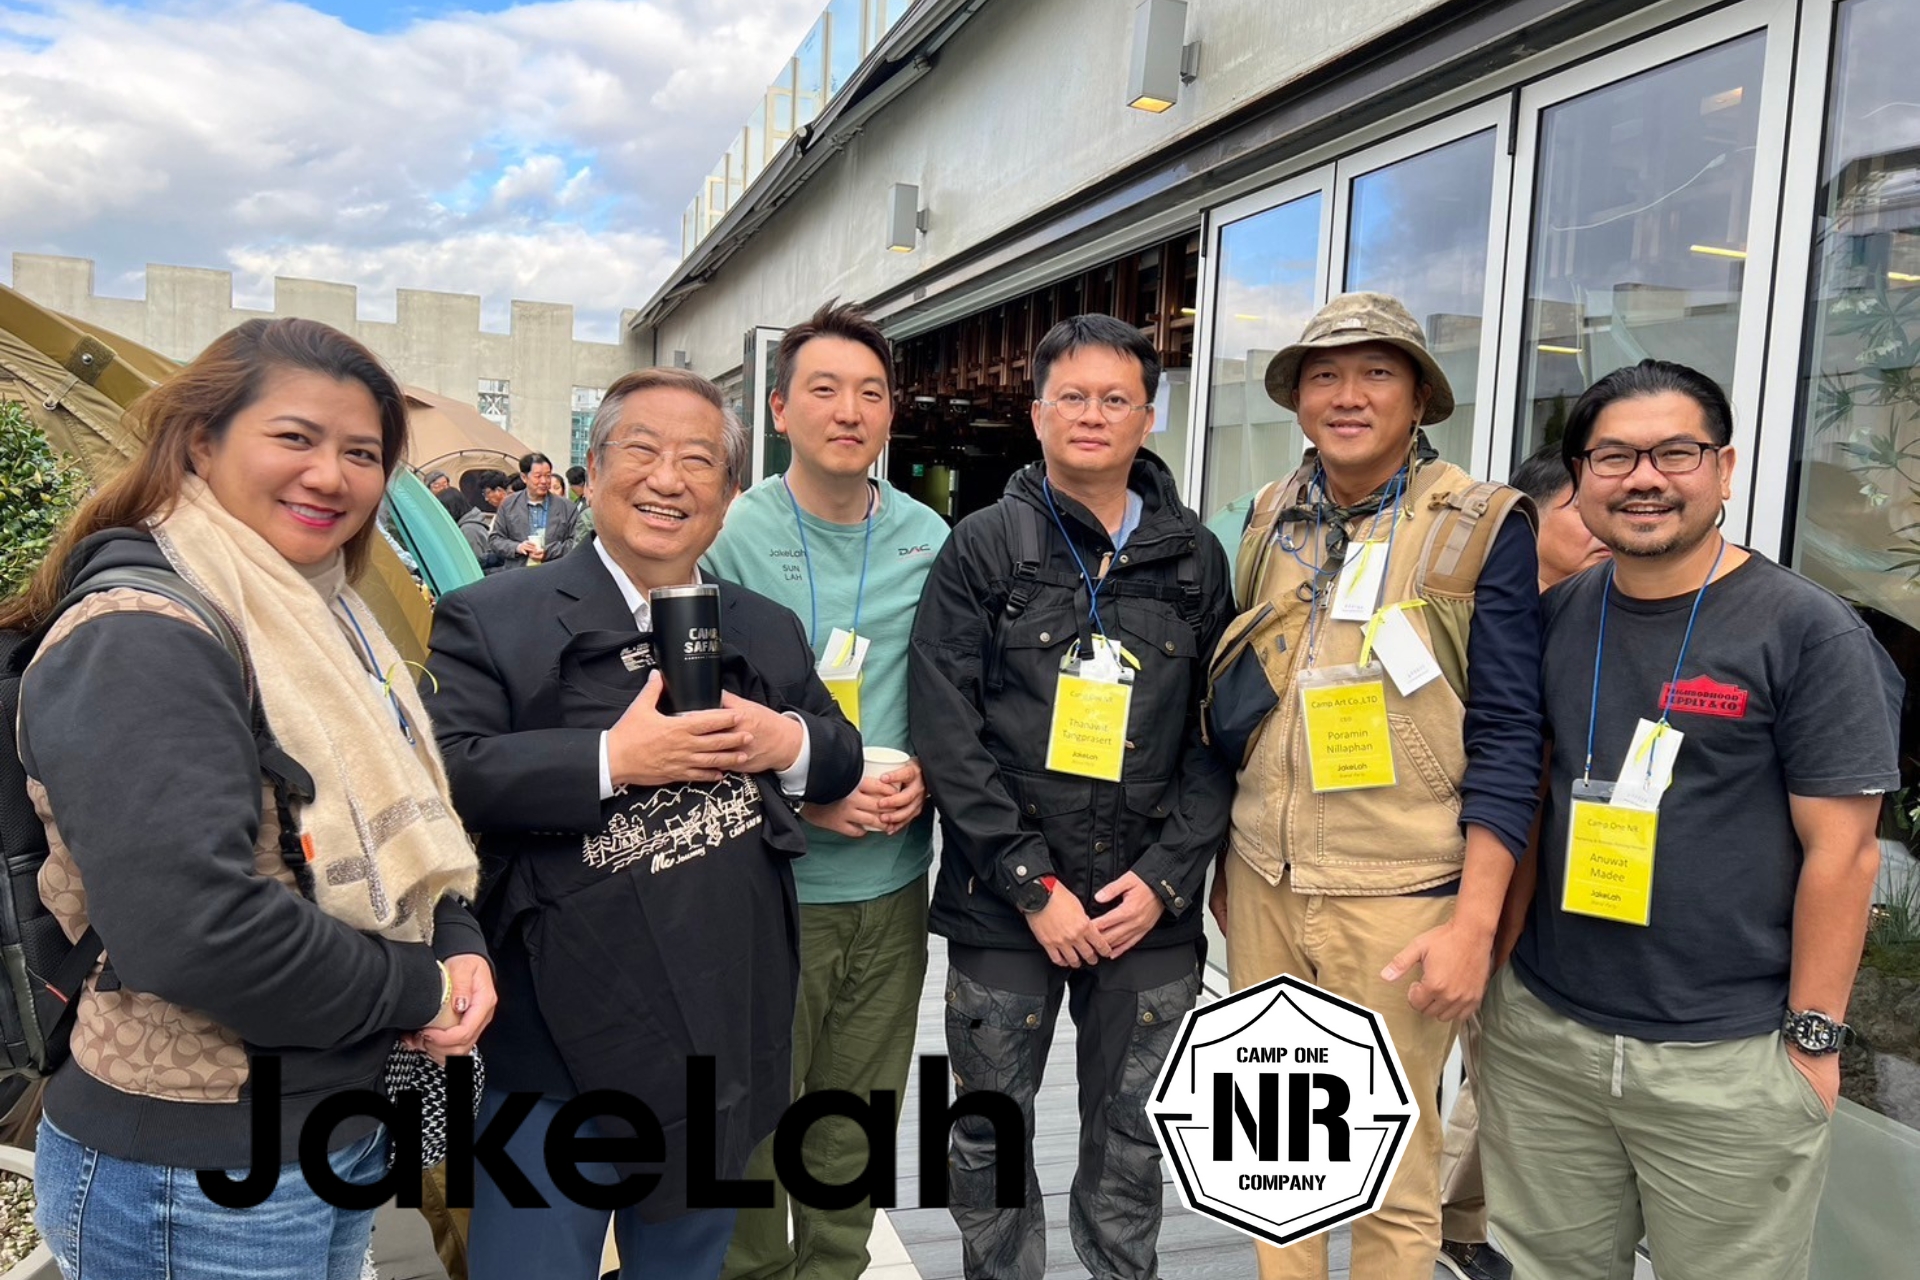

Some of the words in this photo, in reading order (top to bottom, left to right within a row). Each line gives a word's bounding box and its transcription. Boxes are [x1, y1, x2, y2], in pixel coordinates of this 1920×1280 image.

[782, 563, 801, 572] SUN
[784, 573, 803, 582] LAH
[1311, 700, 1333, 710] Camp
[1334, 698, 1346, 707] Art
[1327, 729, 1369, 741] Poramin
[1326, 742, 1373, 755] Nillaphan
[1590, 852, 1628, 869] Anuwat
[1590, 867, 1626, 883] Madee
